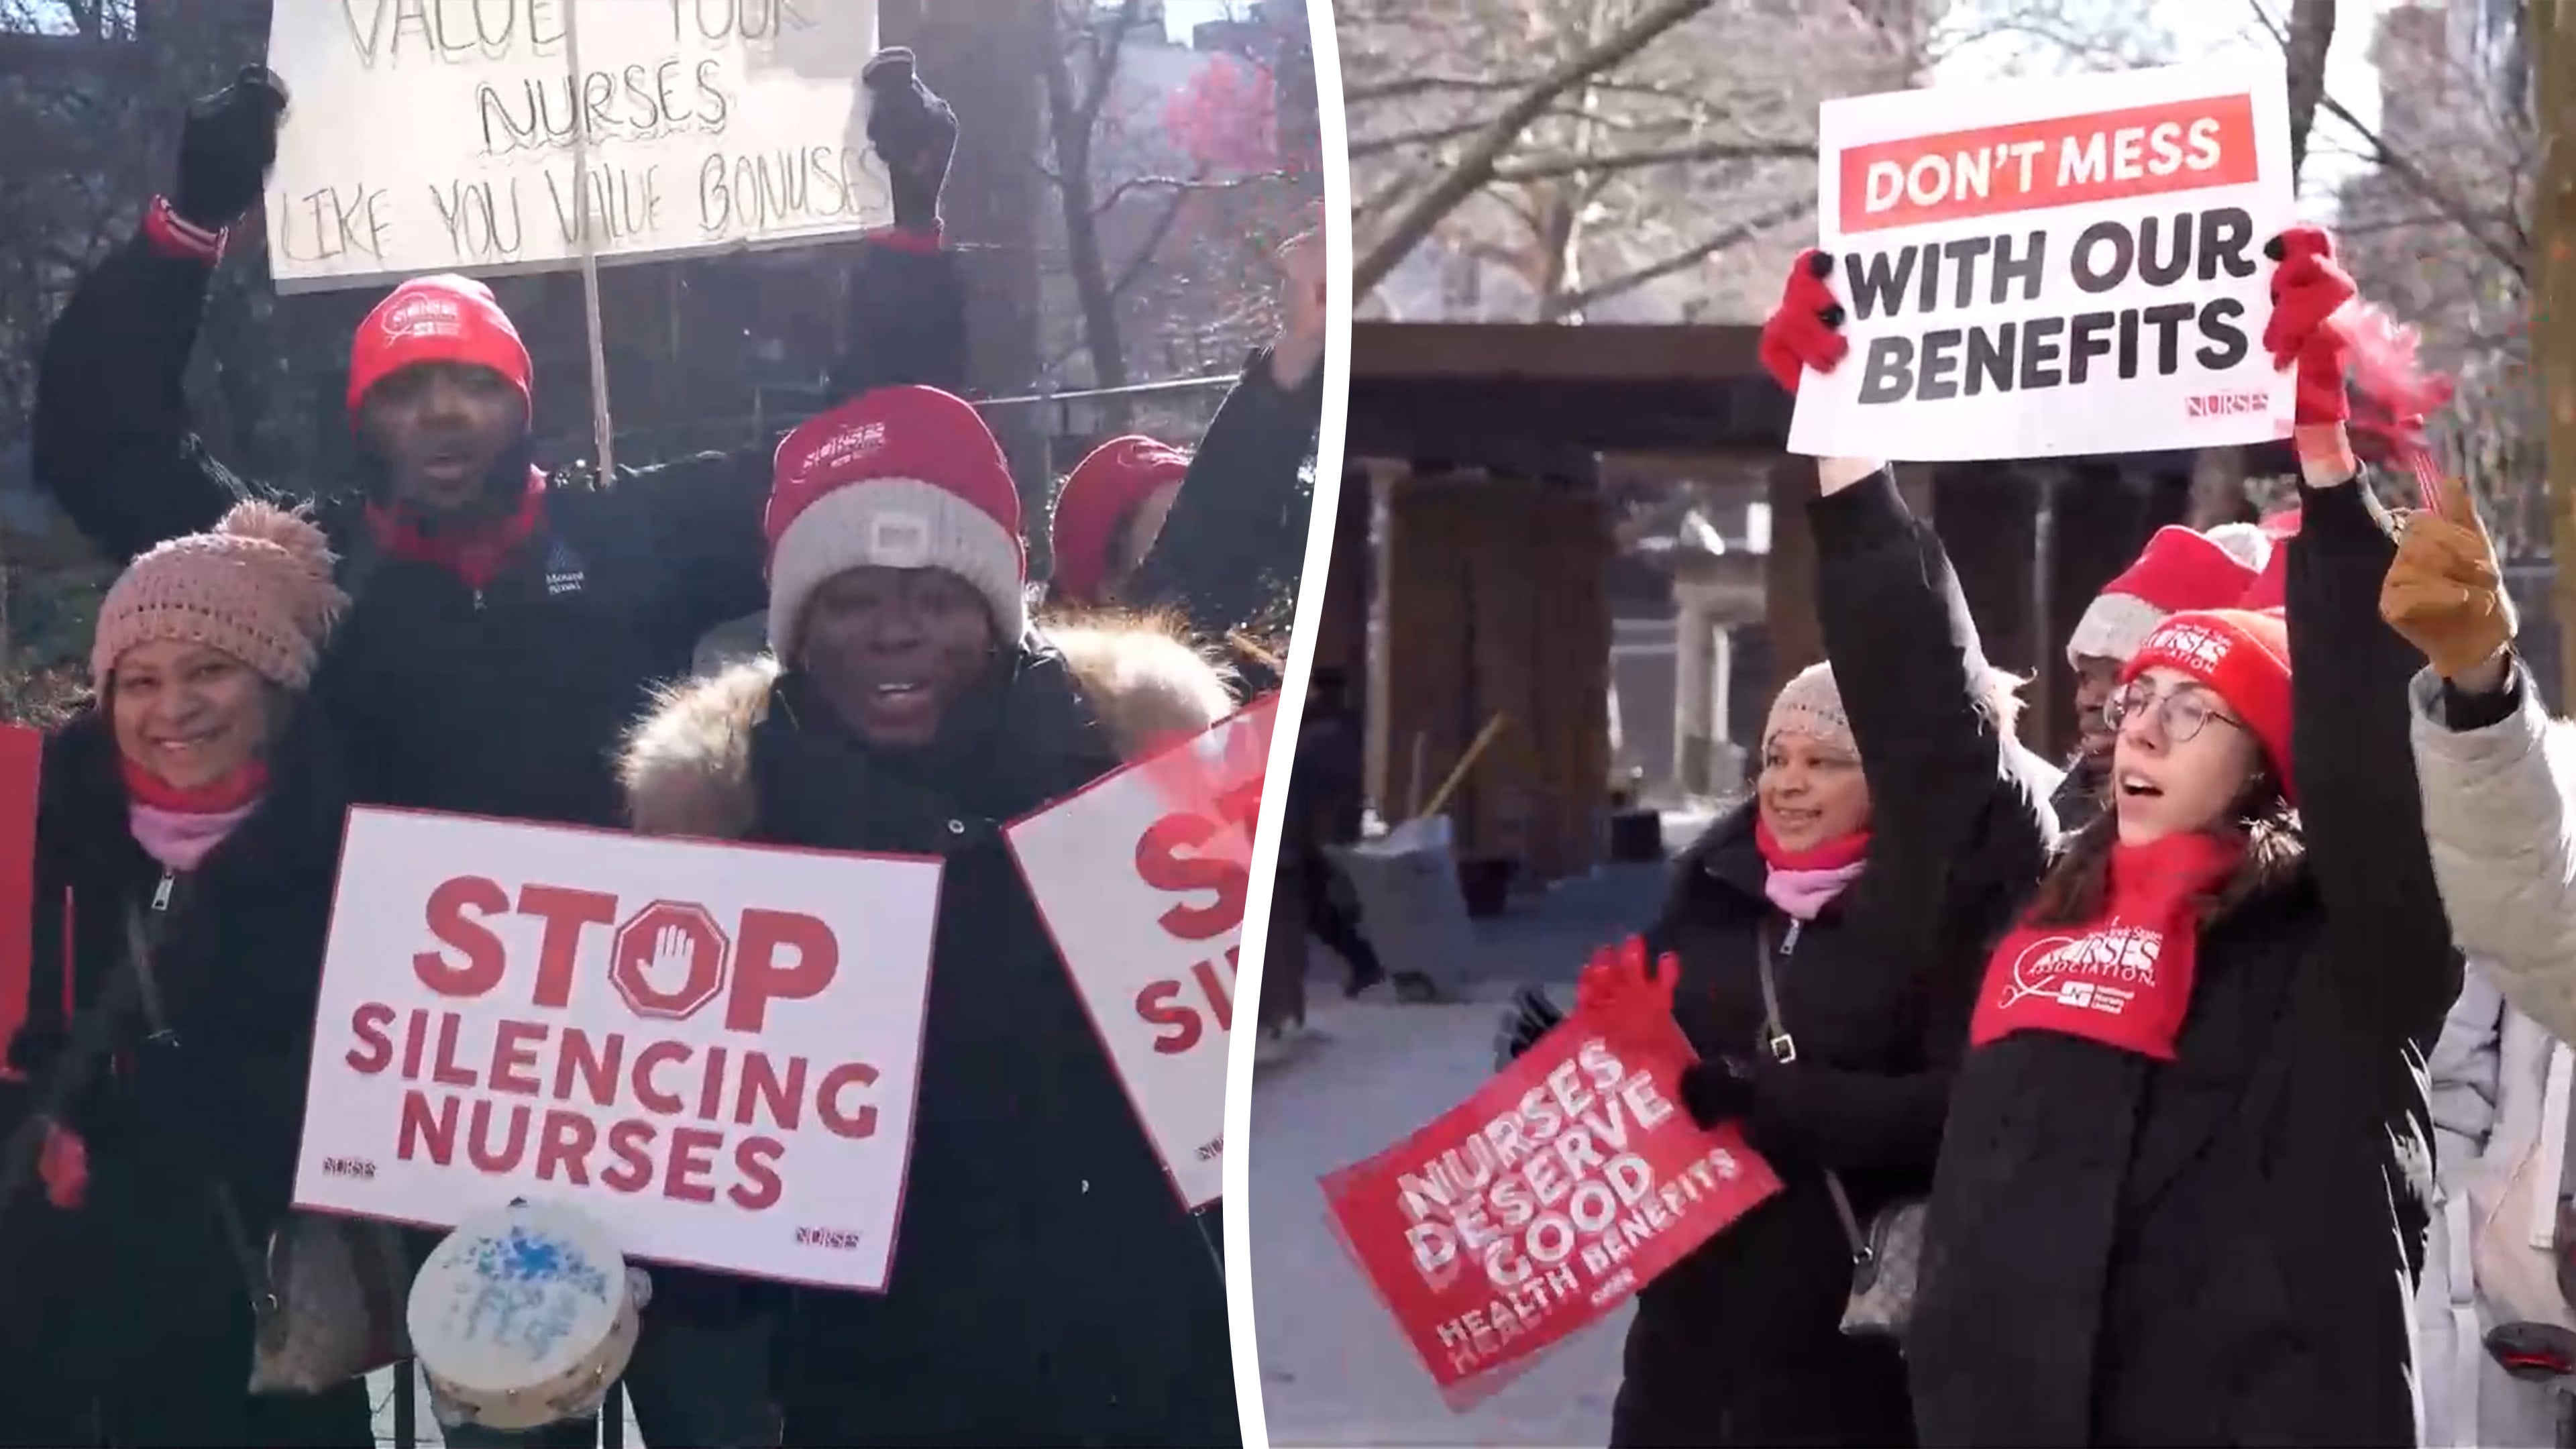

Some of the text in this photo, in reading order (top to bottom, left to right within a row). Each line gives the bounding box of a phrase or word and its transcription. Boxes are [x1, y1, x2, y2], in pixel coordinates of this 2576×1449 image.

[479, 59, 727, 153] NURSES
[1864, 117, 2222, 214] DON'T MESS
[281, 146, 890, 262] LIKE YOU VALUE BONUSES
[1845, 207, 2257, 321] WITH OUR
[1858, 298, 2249, 405] BENEFITS
[413, 874, 839, 1034] STOP
[344, 1002, 880, 1140] SILENCING
[1397, 1036, 1624, 1221] NURSES
[396, 1090, 786, 1211] NURSES
[1405, 1069, 1674, 1273] DESERVE
[1436, 1148, 1741, 1348] HEALTH BENEFITS
[1485, 1152, 1652, 1286] GOOD
